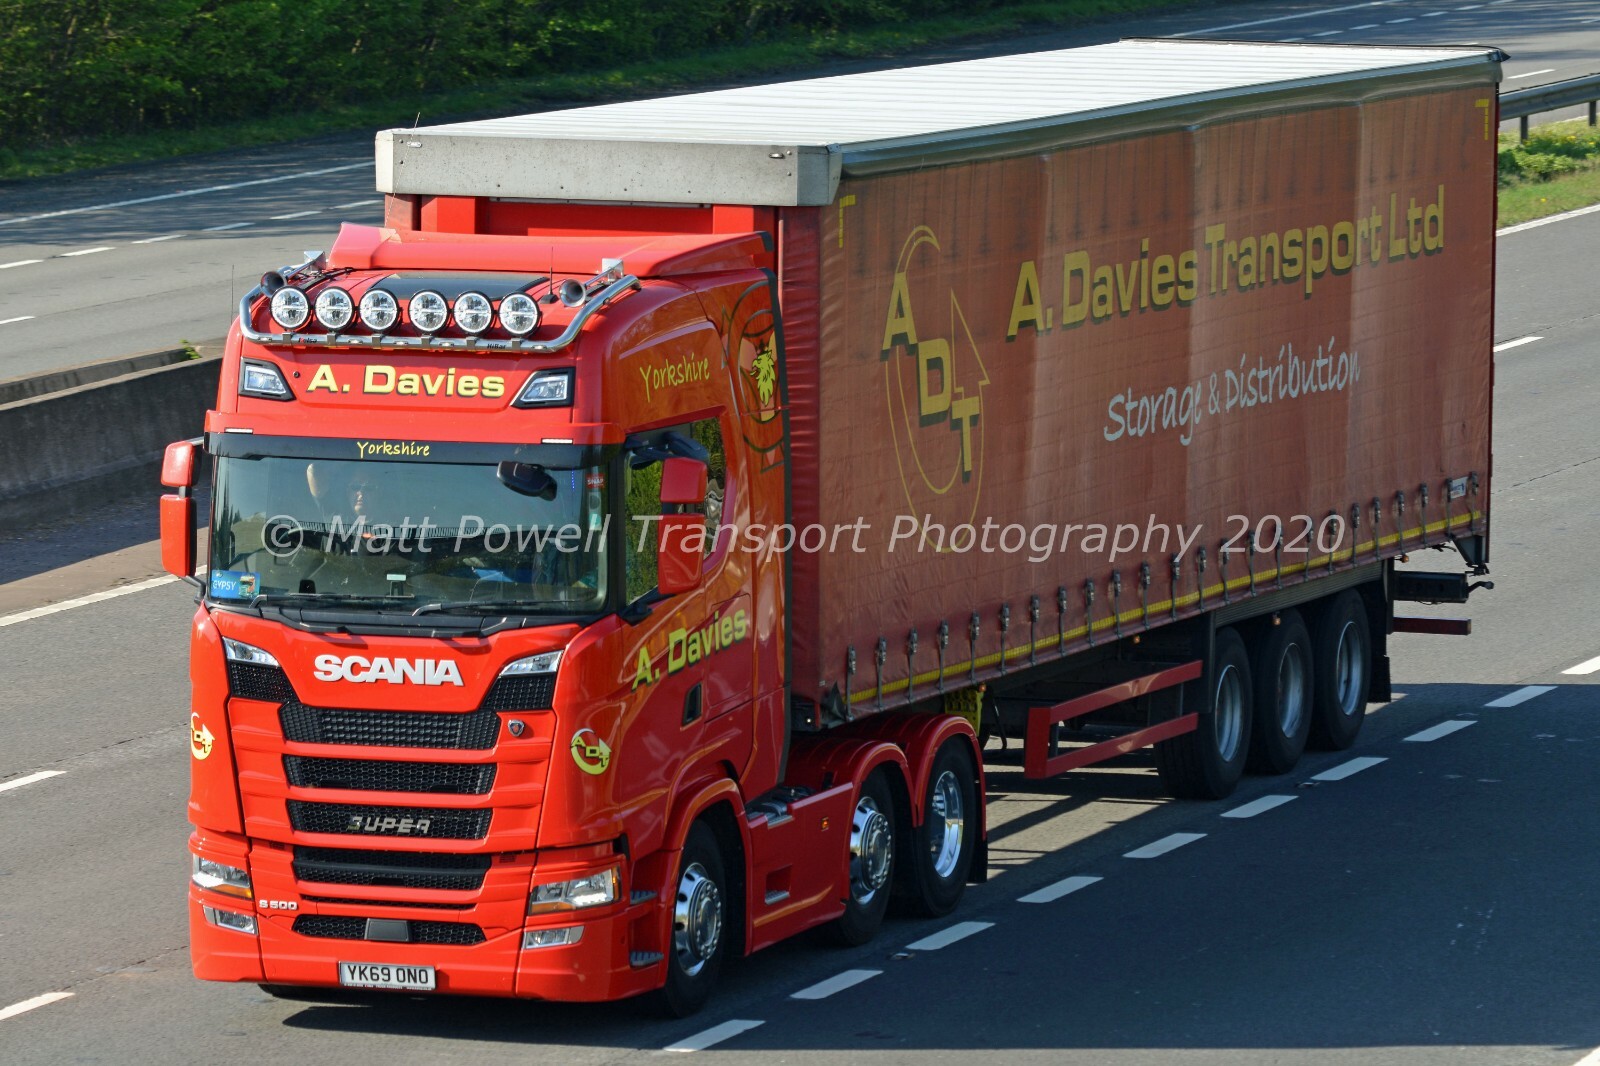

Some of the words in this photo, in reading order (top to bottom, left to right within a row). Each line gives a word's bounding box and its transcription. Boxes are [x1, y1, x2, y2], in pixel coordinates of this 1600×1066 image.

[1006, 260, 1054, 342] A.
[1062, 238, 1199, 332] Davies
[1205, 206, 1383, 299] Transport
[1388, 184, 1445, 263] Ltd
[305, 364, 351, 393] A.
[363, 364, 506, 397] Davies
[639, 352, 710, 403] Yorkshire
[880, 272, 980, 483] ADT
[1103, 387, 1202, 446] Storage
[1208, 371, 1221, 416] &
[1225, 335, 1362, 413] Distribution
[356, 440, 431, 459] Yorkshire
[212, 580, 237, 591] GYPSY
[631, 646, 661, 692] A.
[667, 609, 748, 676] Davies
[313, 654, 465, 687] SCANIA
[570, 736, 610, 768] ADT
[346, 816, 431, 834] SUPER
[270, 900, 298, 911] 500
[347, 965, 391, 982] YK69
[396, 968, 429, 984] ONO
